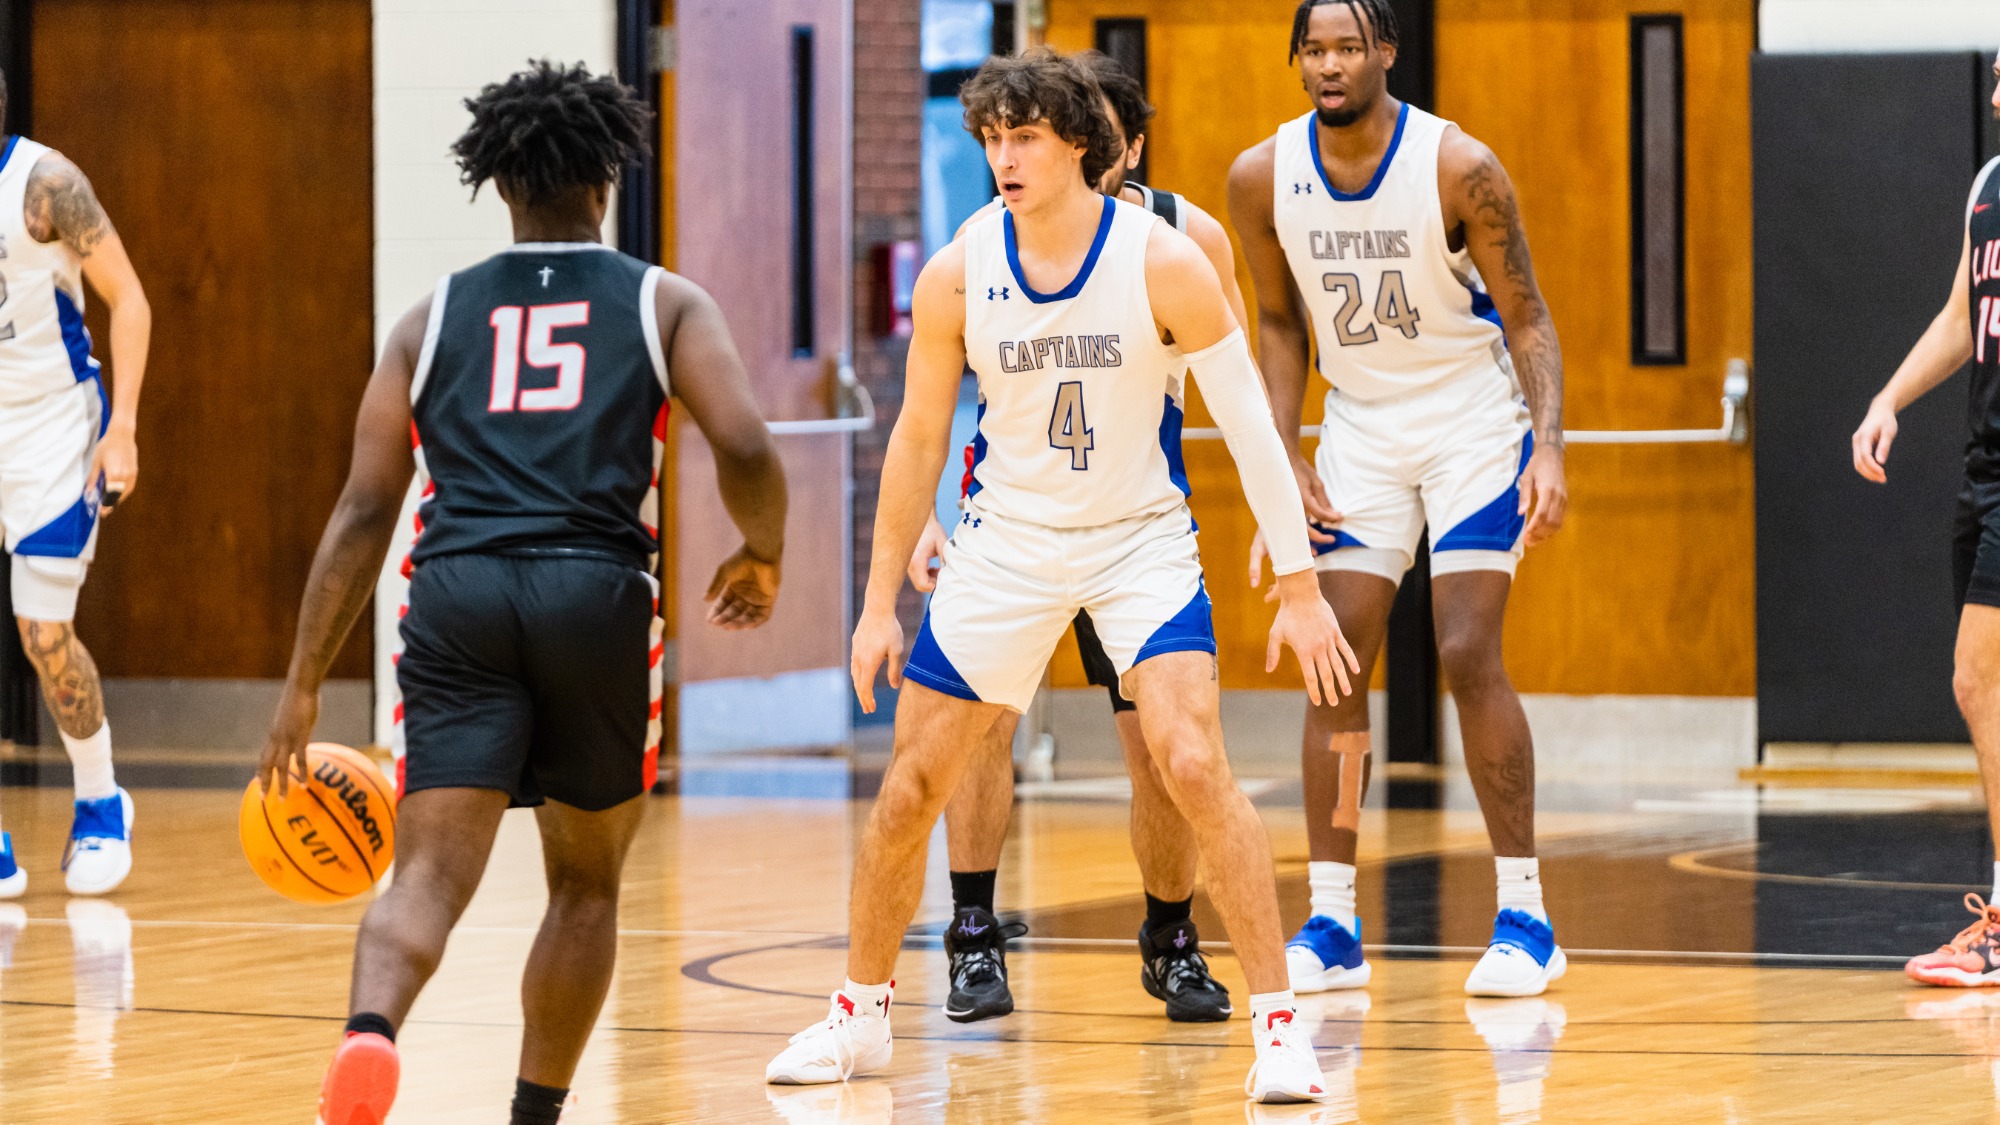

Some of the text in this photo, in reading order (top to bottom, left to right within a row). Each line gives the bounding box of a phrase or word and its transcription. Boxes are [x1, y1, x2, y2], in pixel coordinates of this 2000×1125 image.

[1309, 229, 1411, 260] CAPTAINS
[1322, 270, 1420, 346] 24
[488, 300, 591, 412] 15
[999, 334, 1122, 373] CAPTAINS
[1048, 380, 1095, 471] 4
[313, 761, 385, 858] Wilson
